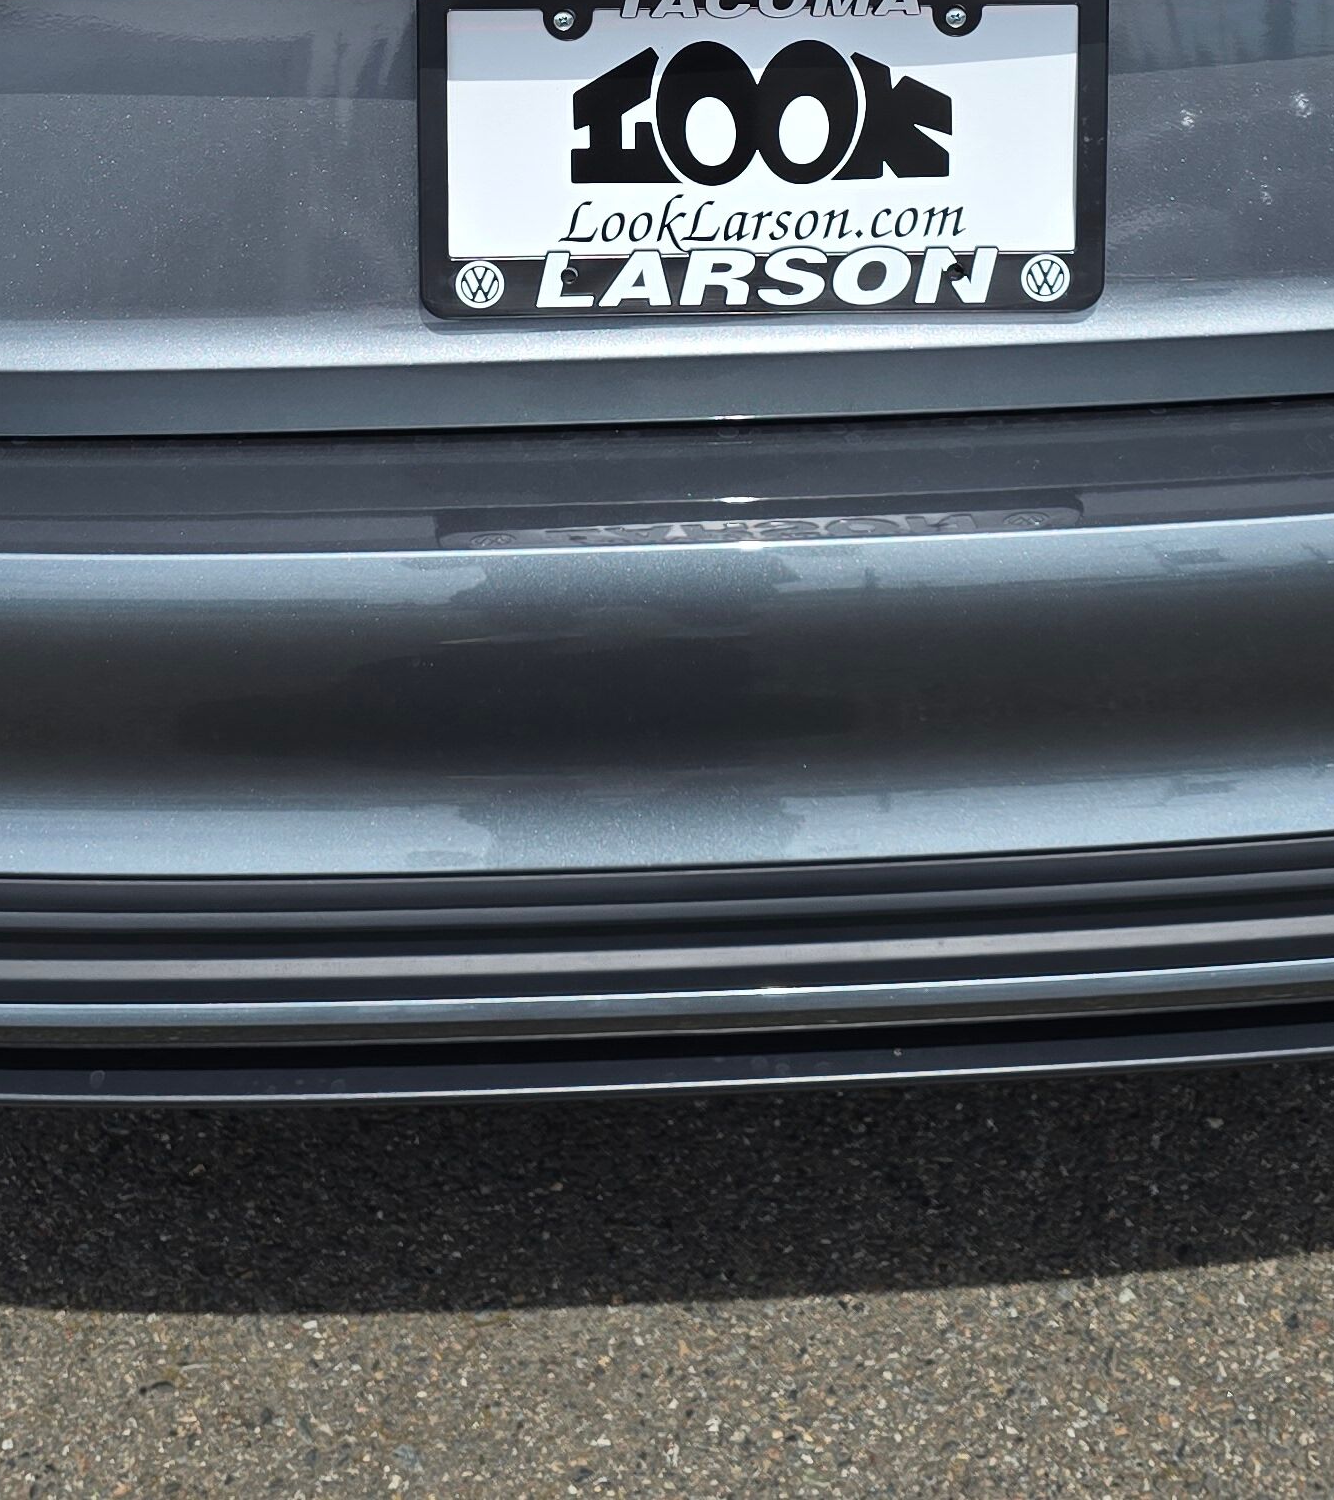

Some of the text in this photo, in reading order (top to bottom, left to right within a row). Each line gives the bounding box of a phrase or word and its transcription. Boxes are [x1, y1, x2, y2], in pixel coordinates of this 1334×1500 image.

[571, 40, 953, 186] LOOK
[559, 193, 967, 252] LookLarson.com
[535, 246, 998, 308] LARSON
